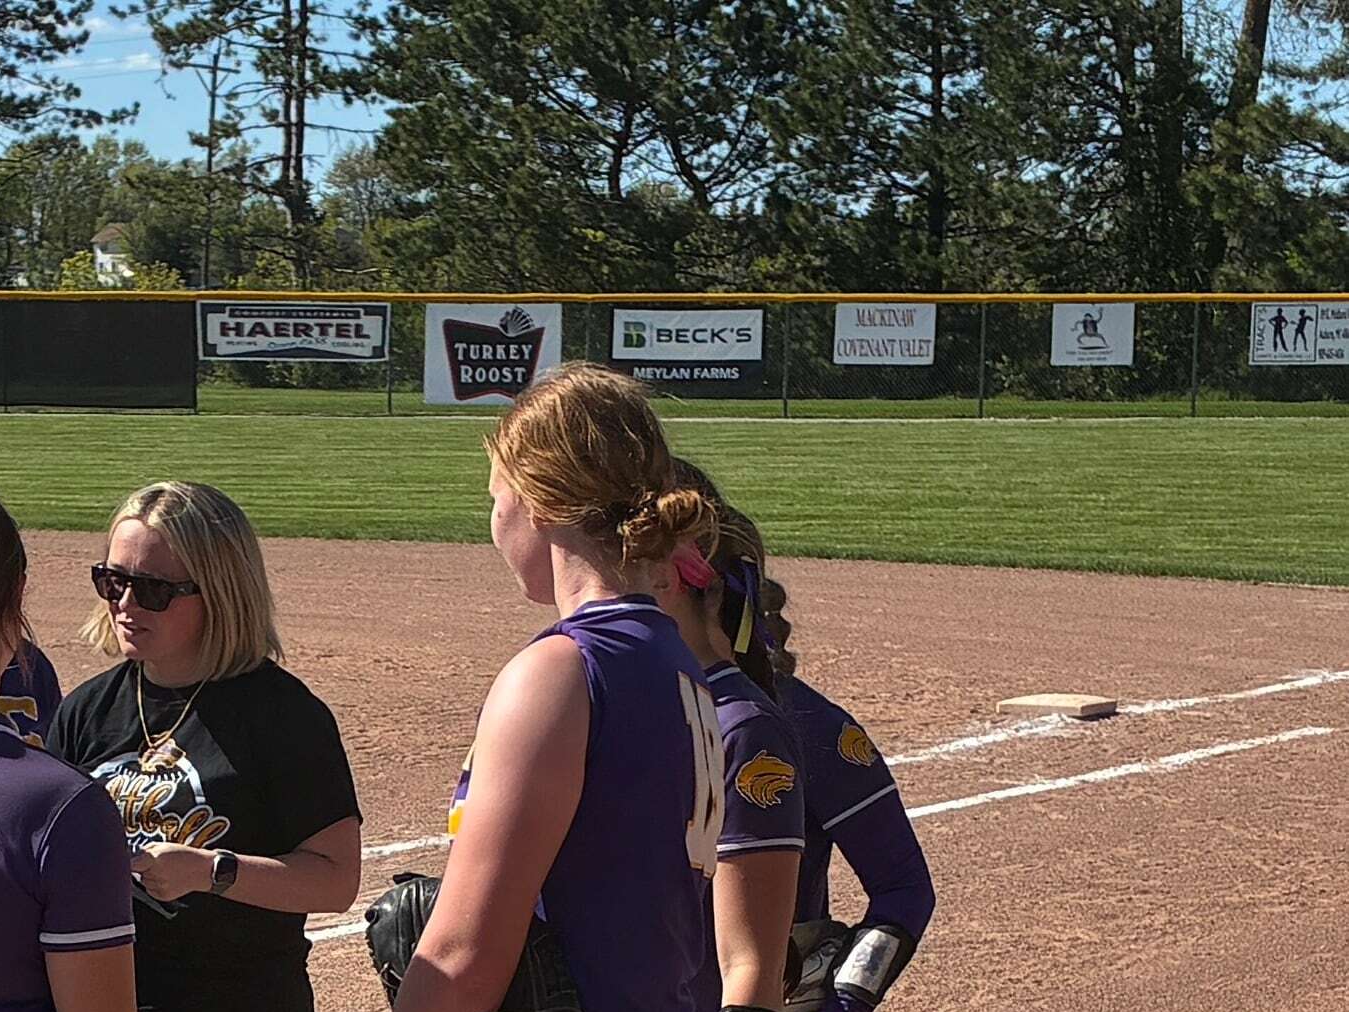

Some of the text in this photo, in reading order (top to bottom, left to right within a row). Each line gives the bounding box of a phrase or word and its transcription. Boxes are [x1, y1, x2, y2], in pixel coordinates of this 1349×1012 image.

[856, 308, 916, 328] MACKINAW
[220, 321, 371, 340] HAERTEL
[656, 327, 752, 344] BECK'S
[454, 341, 533, 361] TURKEY
[837, 338, 933, 358] COVENANT VALET
[460, 365, 527, 384] ROOST
[633, 367, 740, 380] MEYLAN FARMS
